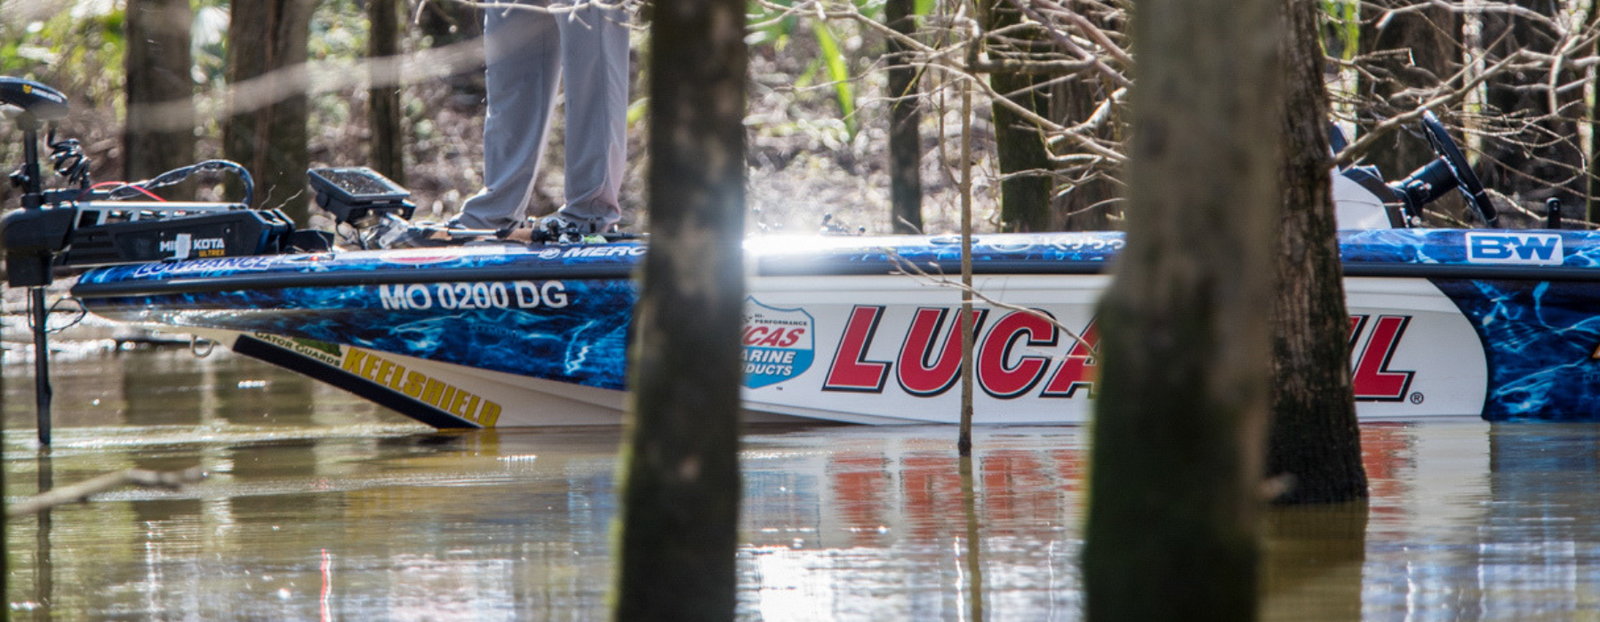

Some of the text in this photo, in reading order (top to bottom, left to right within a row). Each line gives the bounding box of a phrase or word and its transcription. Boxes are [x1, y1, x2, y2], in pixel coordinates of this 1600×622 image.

[193, 238, 225, 250] KOTA
[566, 247, 647, 259] MERC
[133, 257, 271, 278] LOWRANCE
[380, 280, 568, 309] MO 0200 DG
[742, 326, 806, 347] CAS
[255, 331, 341, 367] GATOR GUARDS
[743, 349, 796, 364] ARINE
[821, 304, 1102, 399] LUCA
[745, 364, 793, 376] DUCTS
[342, 348, 502, 428] KEELSHIELD
